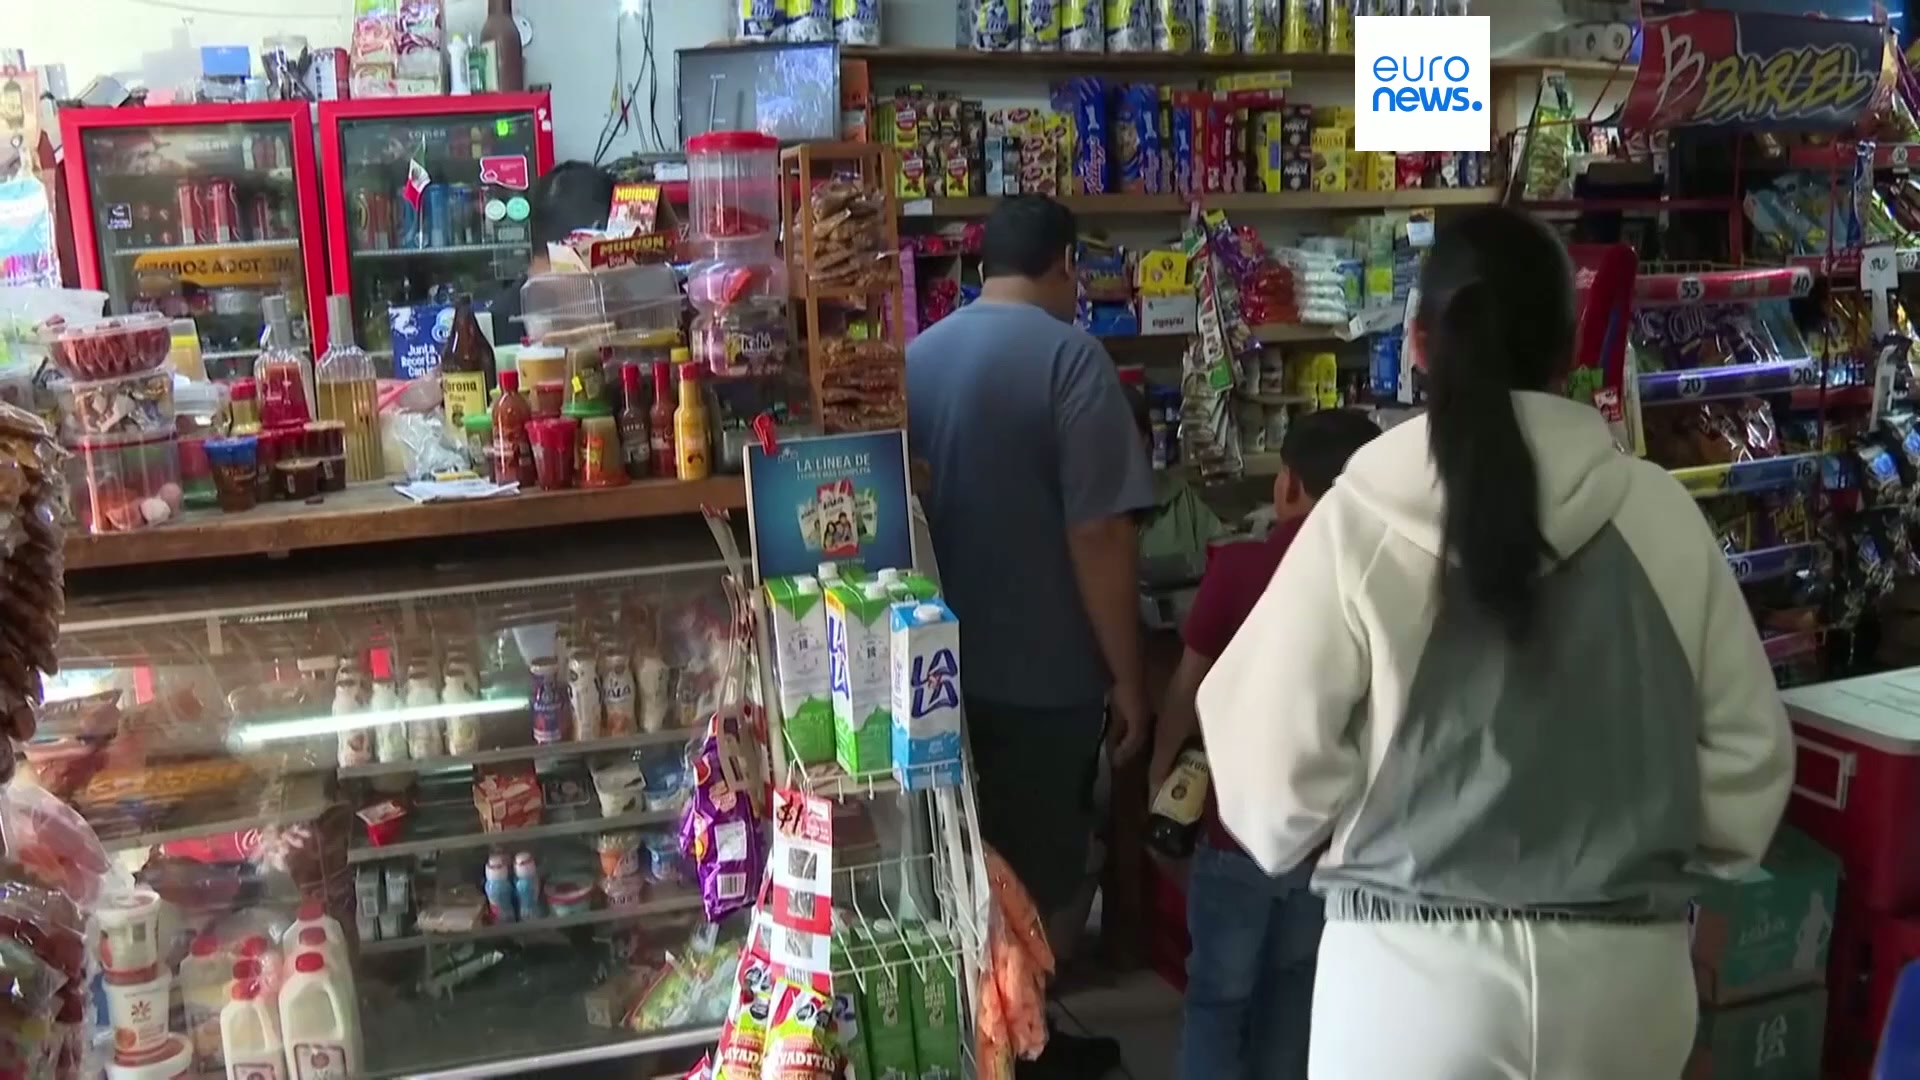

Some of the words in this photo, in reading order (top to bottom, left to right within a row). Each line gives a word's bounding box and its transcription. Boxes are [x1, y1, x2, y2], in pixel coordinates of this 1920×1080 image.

[1693, 49, 1876, 119] BARCEL
[1681, 280, 1700, 298] 55
[1794, 275, 1810, 293] 40
[1683, 378, 1701, 393] 20
[796, 458, 812, 473] LA
[816, 454, 851, 471] LÍNEA
[855, 453, 871, 466] DE
